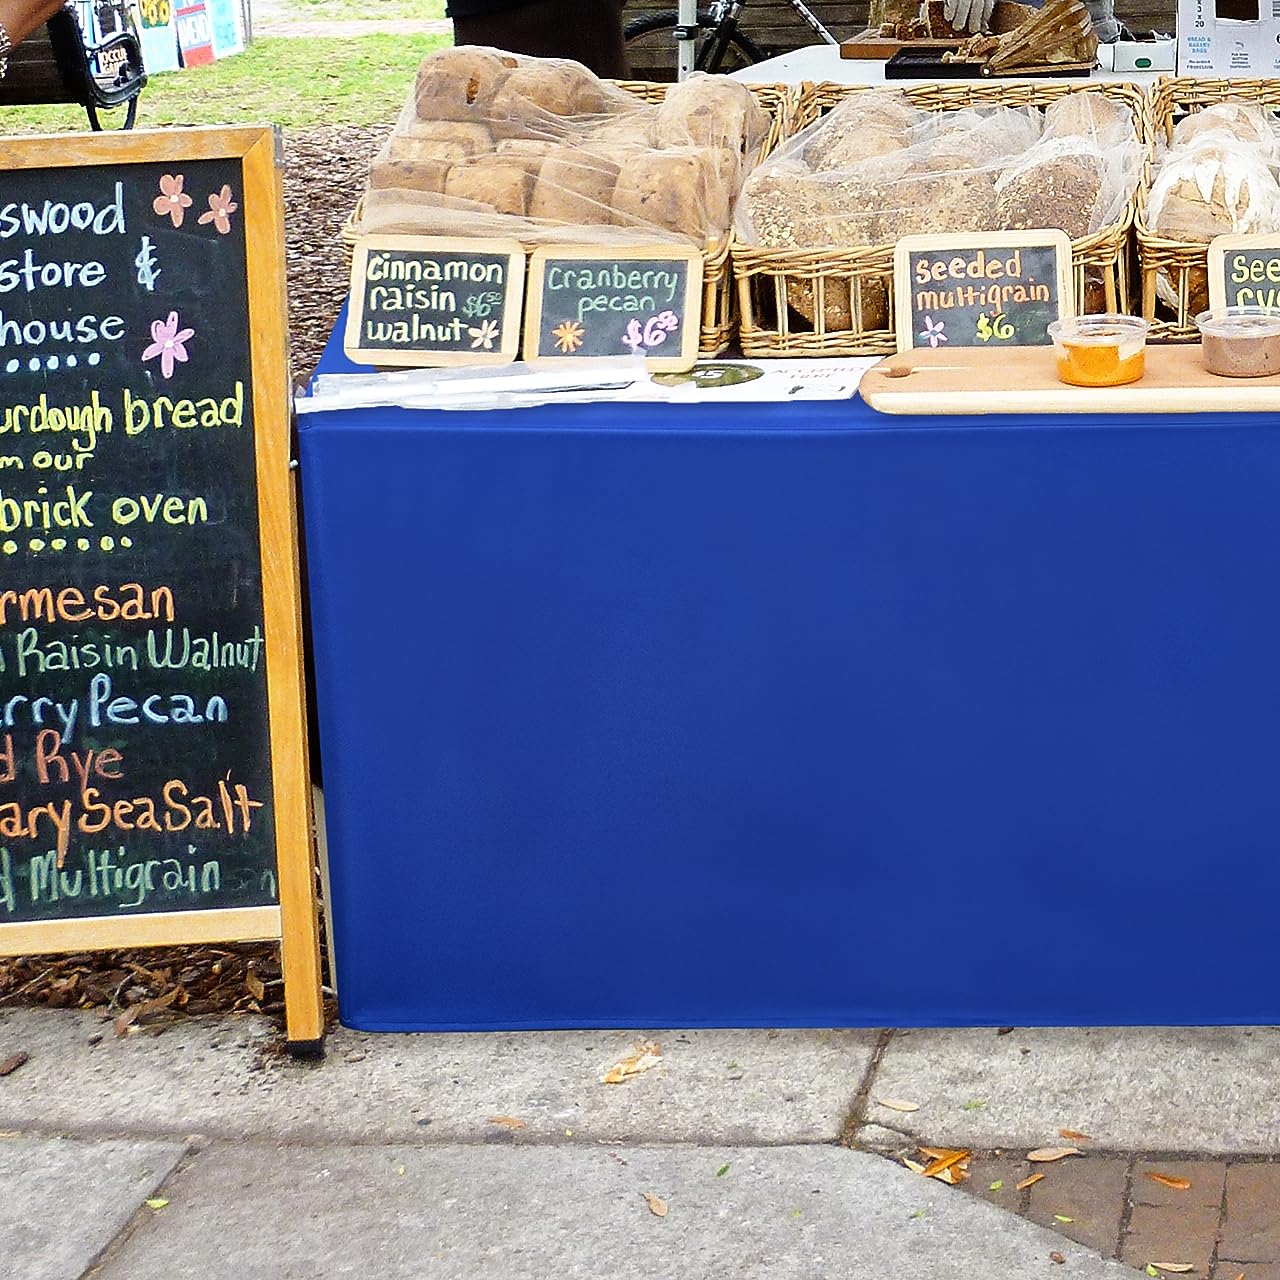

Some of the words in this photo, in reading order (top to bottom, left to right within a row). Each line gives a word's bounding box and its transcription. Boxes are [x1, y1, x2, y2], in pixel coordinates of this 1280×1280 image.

[0, 248, 107, 293] store
[136, 235, 162, 291] &
[369, 283, 457, 313] raisin
[577, 293, 657, 323] pecan
[916, 277, 1050, 317] multigrain
[0, 309, 125, 347] house
[366, 314, 470, 342] walnut
[975, 312, 1015, 343] $6
[124, 381, 243, 436] bread
[32, 450, 94, 471] our
[0, 485, 94, 533] brick
[112, 493, 208, 525] oven
[17, 627, 138, 677] Raisin
[147, 625, 265, 671] Walnut
[90, 672, 229, 727] Pecan
[36, 728, 125, 792] Rye
[30, 844, 221, 909] Multigrain
